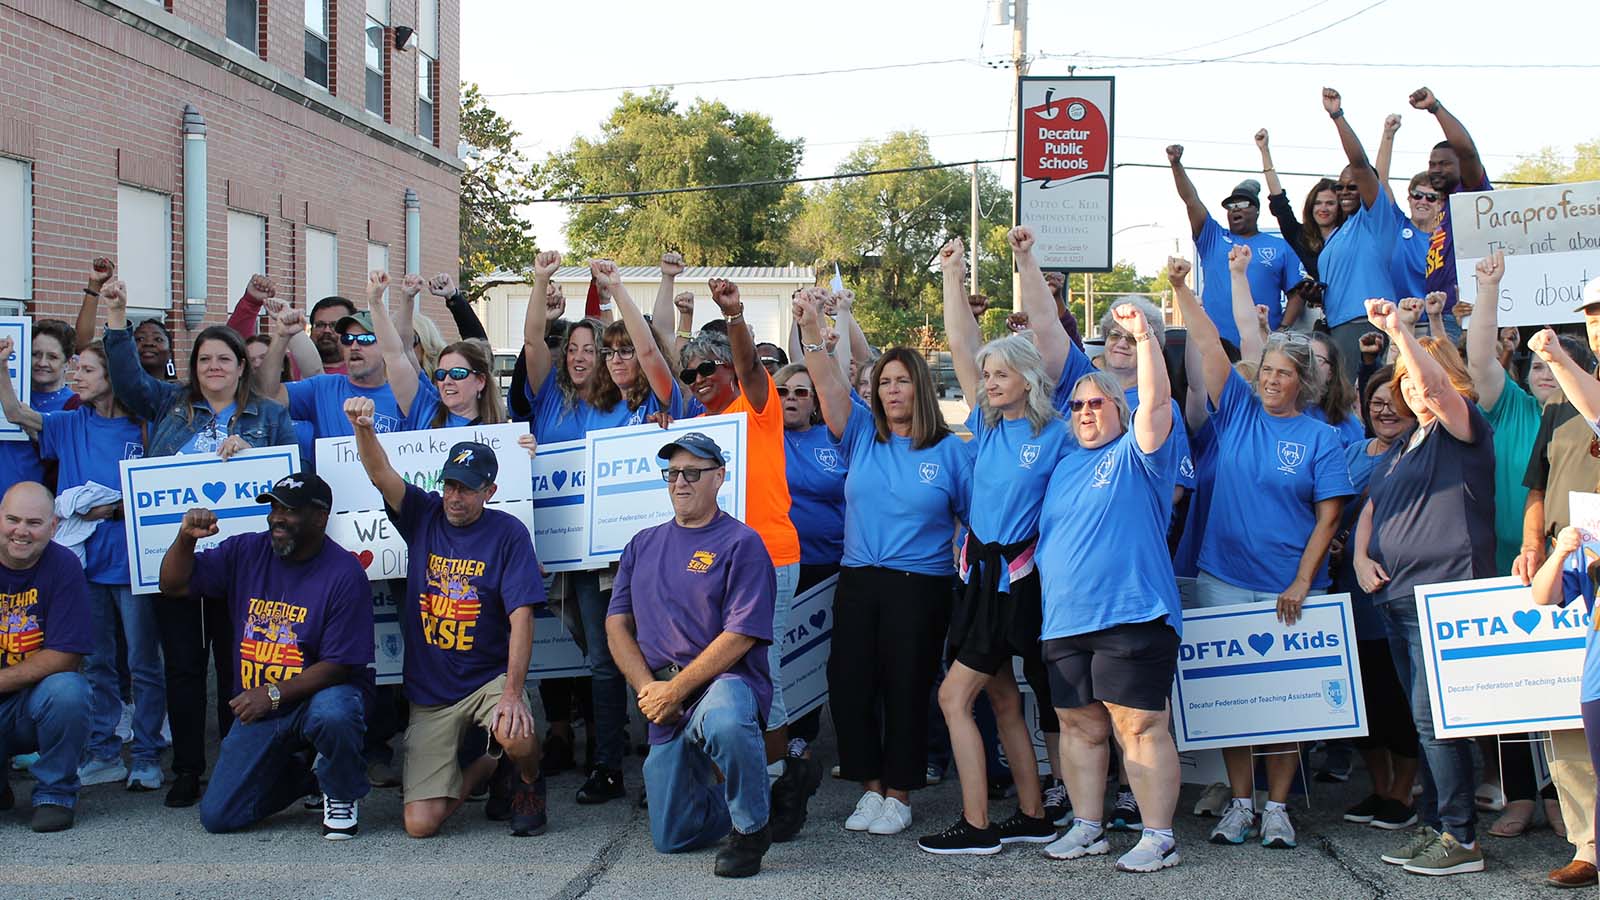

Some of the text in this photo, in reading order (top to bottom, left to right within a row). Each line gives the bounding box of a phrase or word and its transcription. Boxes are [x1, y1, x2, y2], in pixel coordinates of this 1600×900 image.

[1039, 127, 1090, 141] Decatur
[1045, 142, 1084, 155] Public
[1039, 157, 1089, 170] Schools
[1530, 232, 1557, 254] not
[398, 435, 447, 456] make
[597, 457, 651, 478] DFTA
[532, 470, 586, 492] TA Ki
[137, 480, 273, 508] DFTA Kid
[353, 518, 390, 543] WE
[431, 595, 457, 618] WE
[783, 624, 810, 647] TA
[1436, 609, 1590, 640] DFTA Ki
[255, 641, 287, 664] WE
[1180, 631, 1340, 662] DFTA Kids
[1448, 685, 1475, 694] Decatur
[1476, 682, 1514, 690] Federation
[1524, 678, 1555, 687] Teaching
[1557, 675, 1583, 684] Assist
[1189, 700, 1214, 709] Decatur
[1214, 698, 1249, 707] Federation
[1258, 694, 1287, 703] Teaching
[1287, 691, 1322, 700] Assistants
